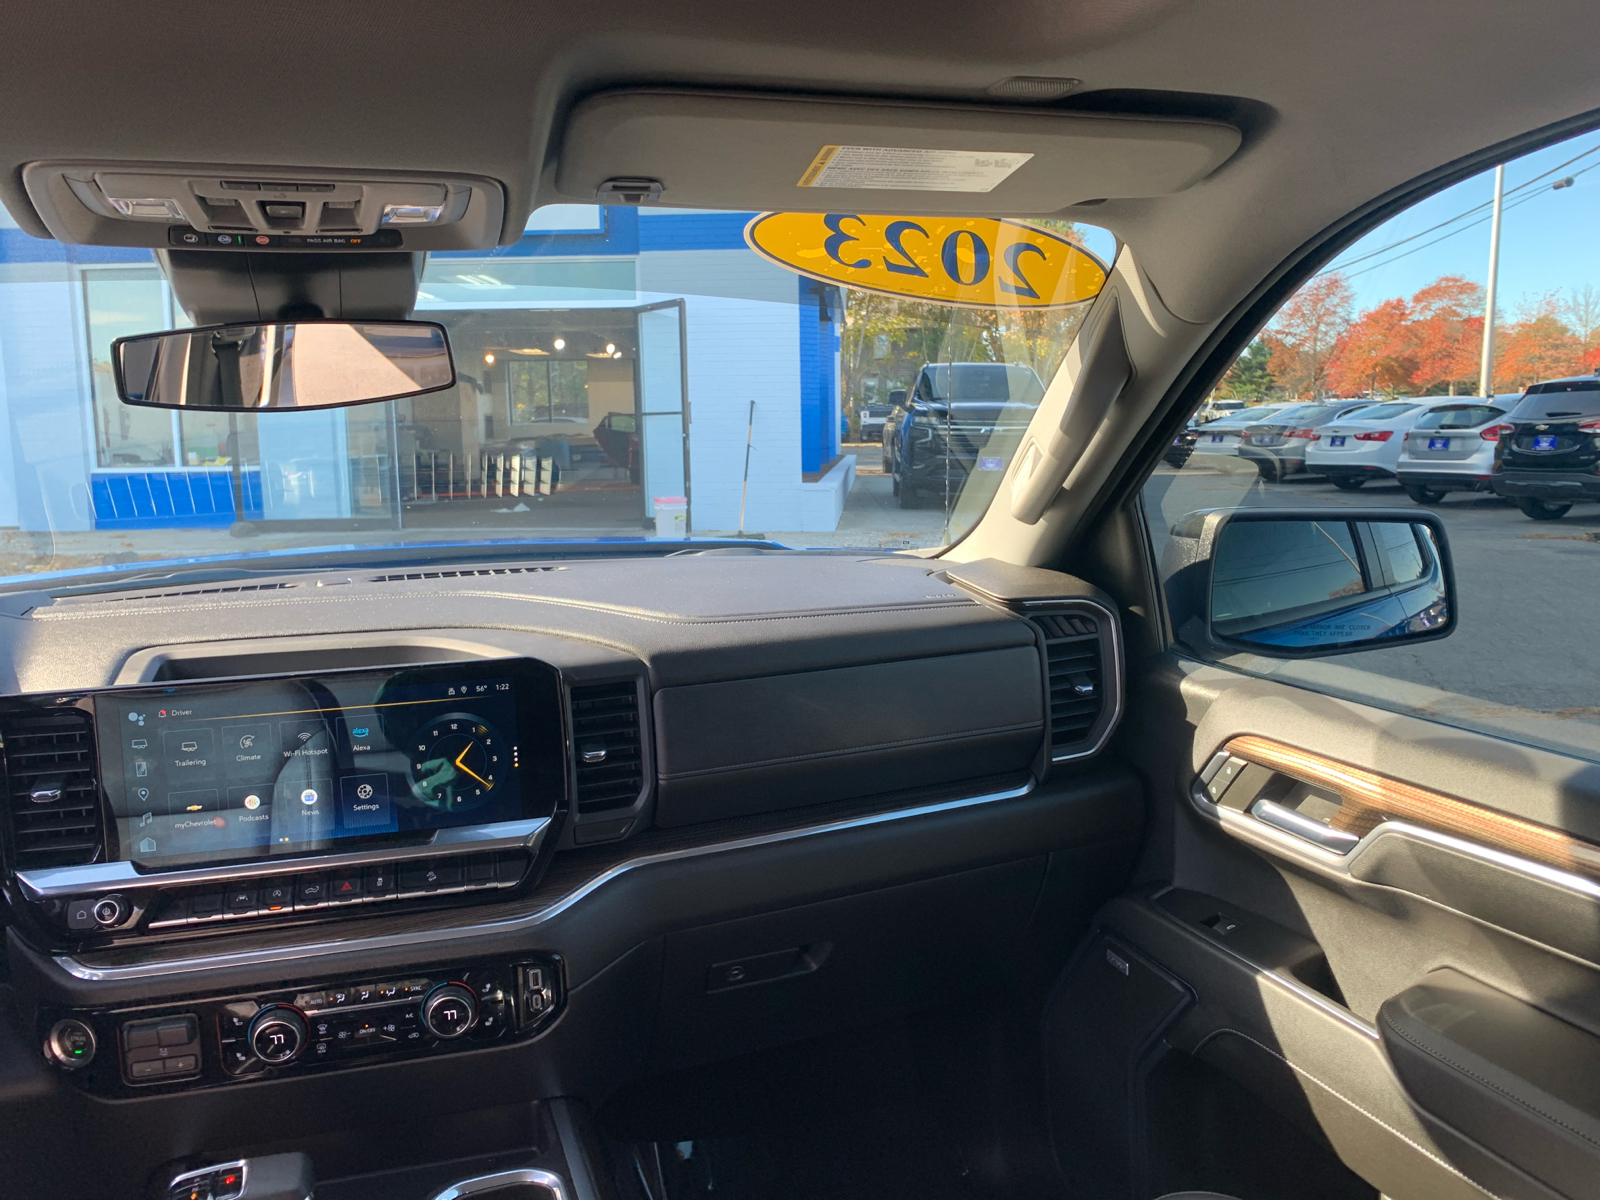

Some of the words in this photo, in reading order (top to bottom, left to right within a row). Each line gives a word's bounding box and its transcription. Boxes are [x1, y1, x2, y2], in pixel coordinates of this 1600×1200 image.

[495, 683, 510, 691] 1:22
[171, 709, 192, 717] Driver
[353, 744, 371, 752] Alexa
[283, 750, 301, 758] Wi-Fi
[301, 748, 328, 757] Hotspot
[174, 759, 207, 767] Trailering
[353, 803, 380, 812] Settings
[238, 814, 269, 822] Podcasts
[174, 818, 217, 829] myChevrolet
[443, 1010, 458, 1021] 77
[269, 1034, 285, 1045] 77
